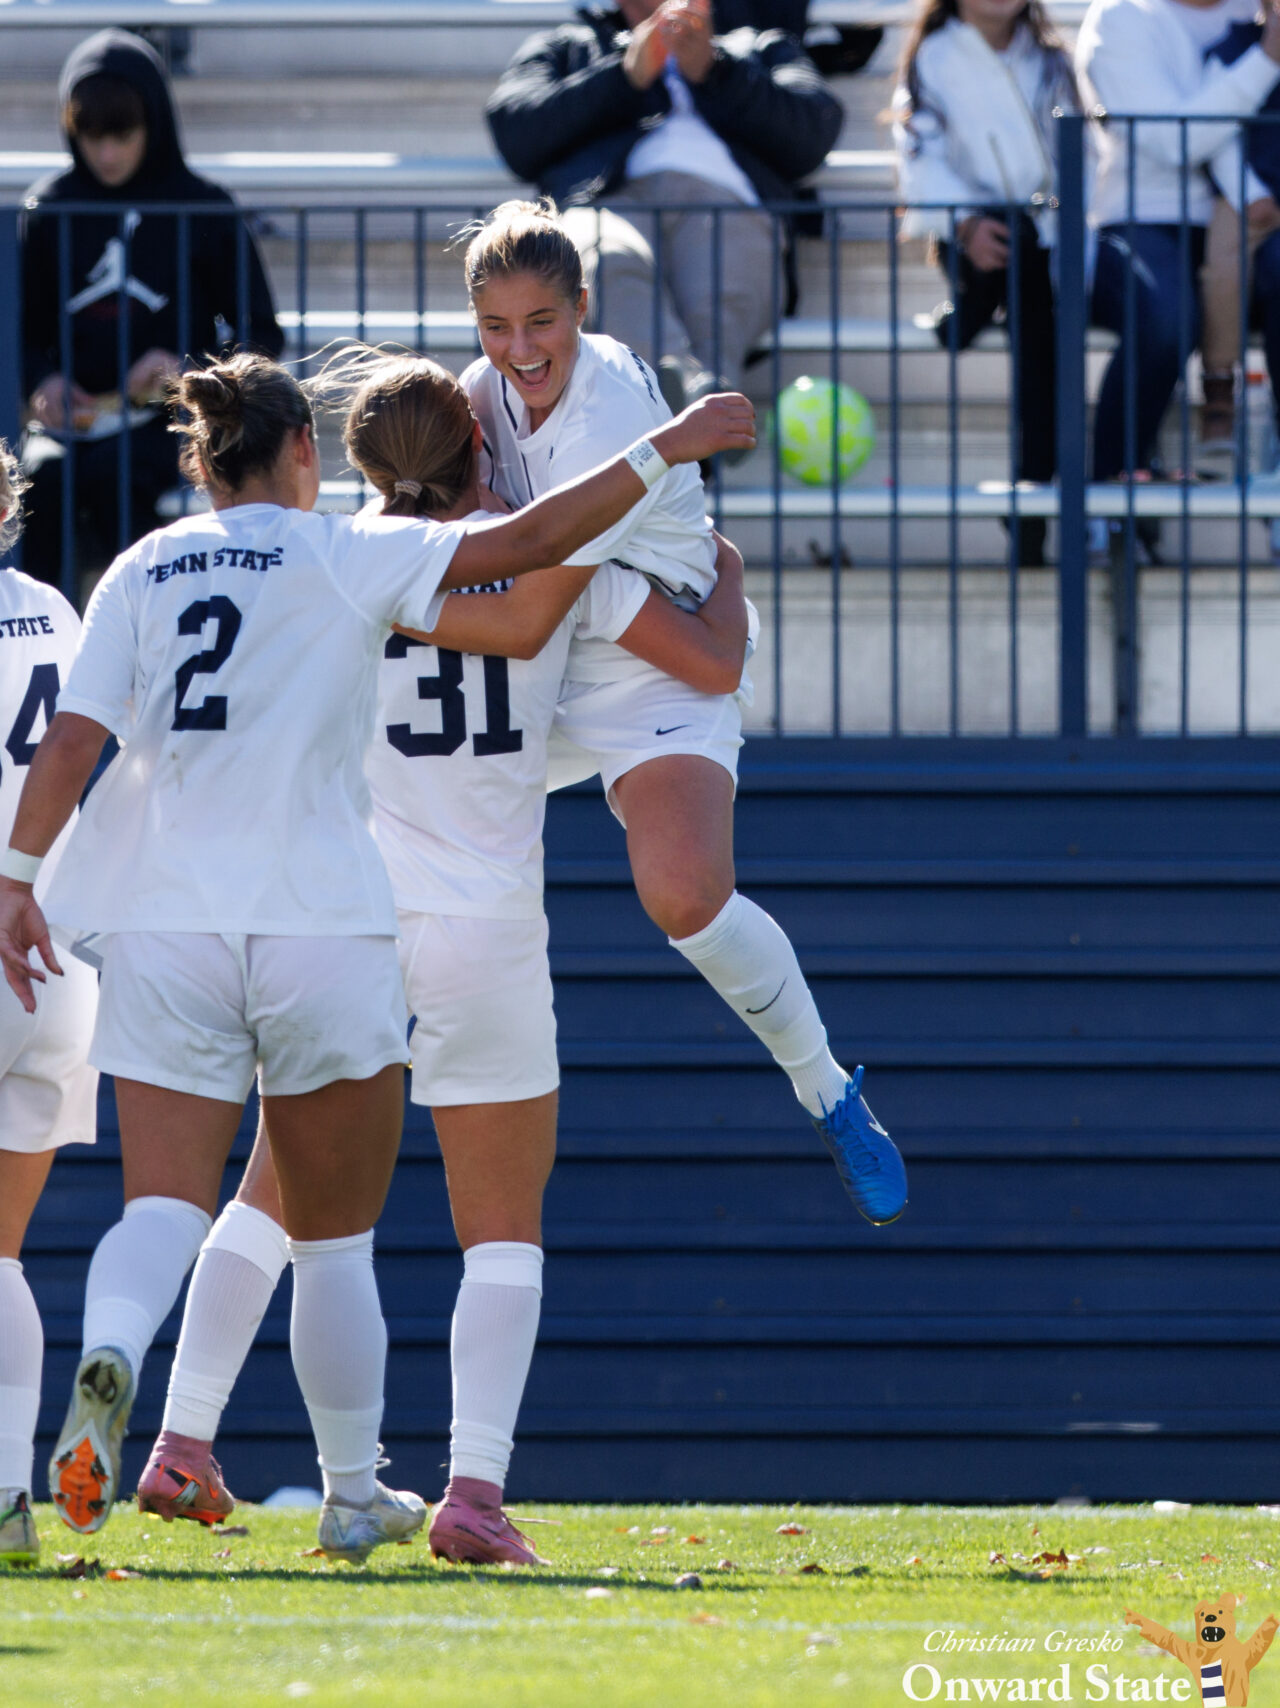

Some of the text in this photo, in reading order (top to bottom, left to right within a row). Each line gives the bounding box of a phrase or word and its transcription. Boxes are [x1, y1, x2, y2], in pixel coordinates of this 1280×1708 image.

[213, 547, 283, 572] STATE
[171, 595, 242, 731] 2
[384, 631, 523, 758] 31
